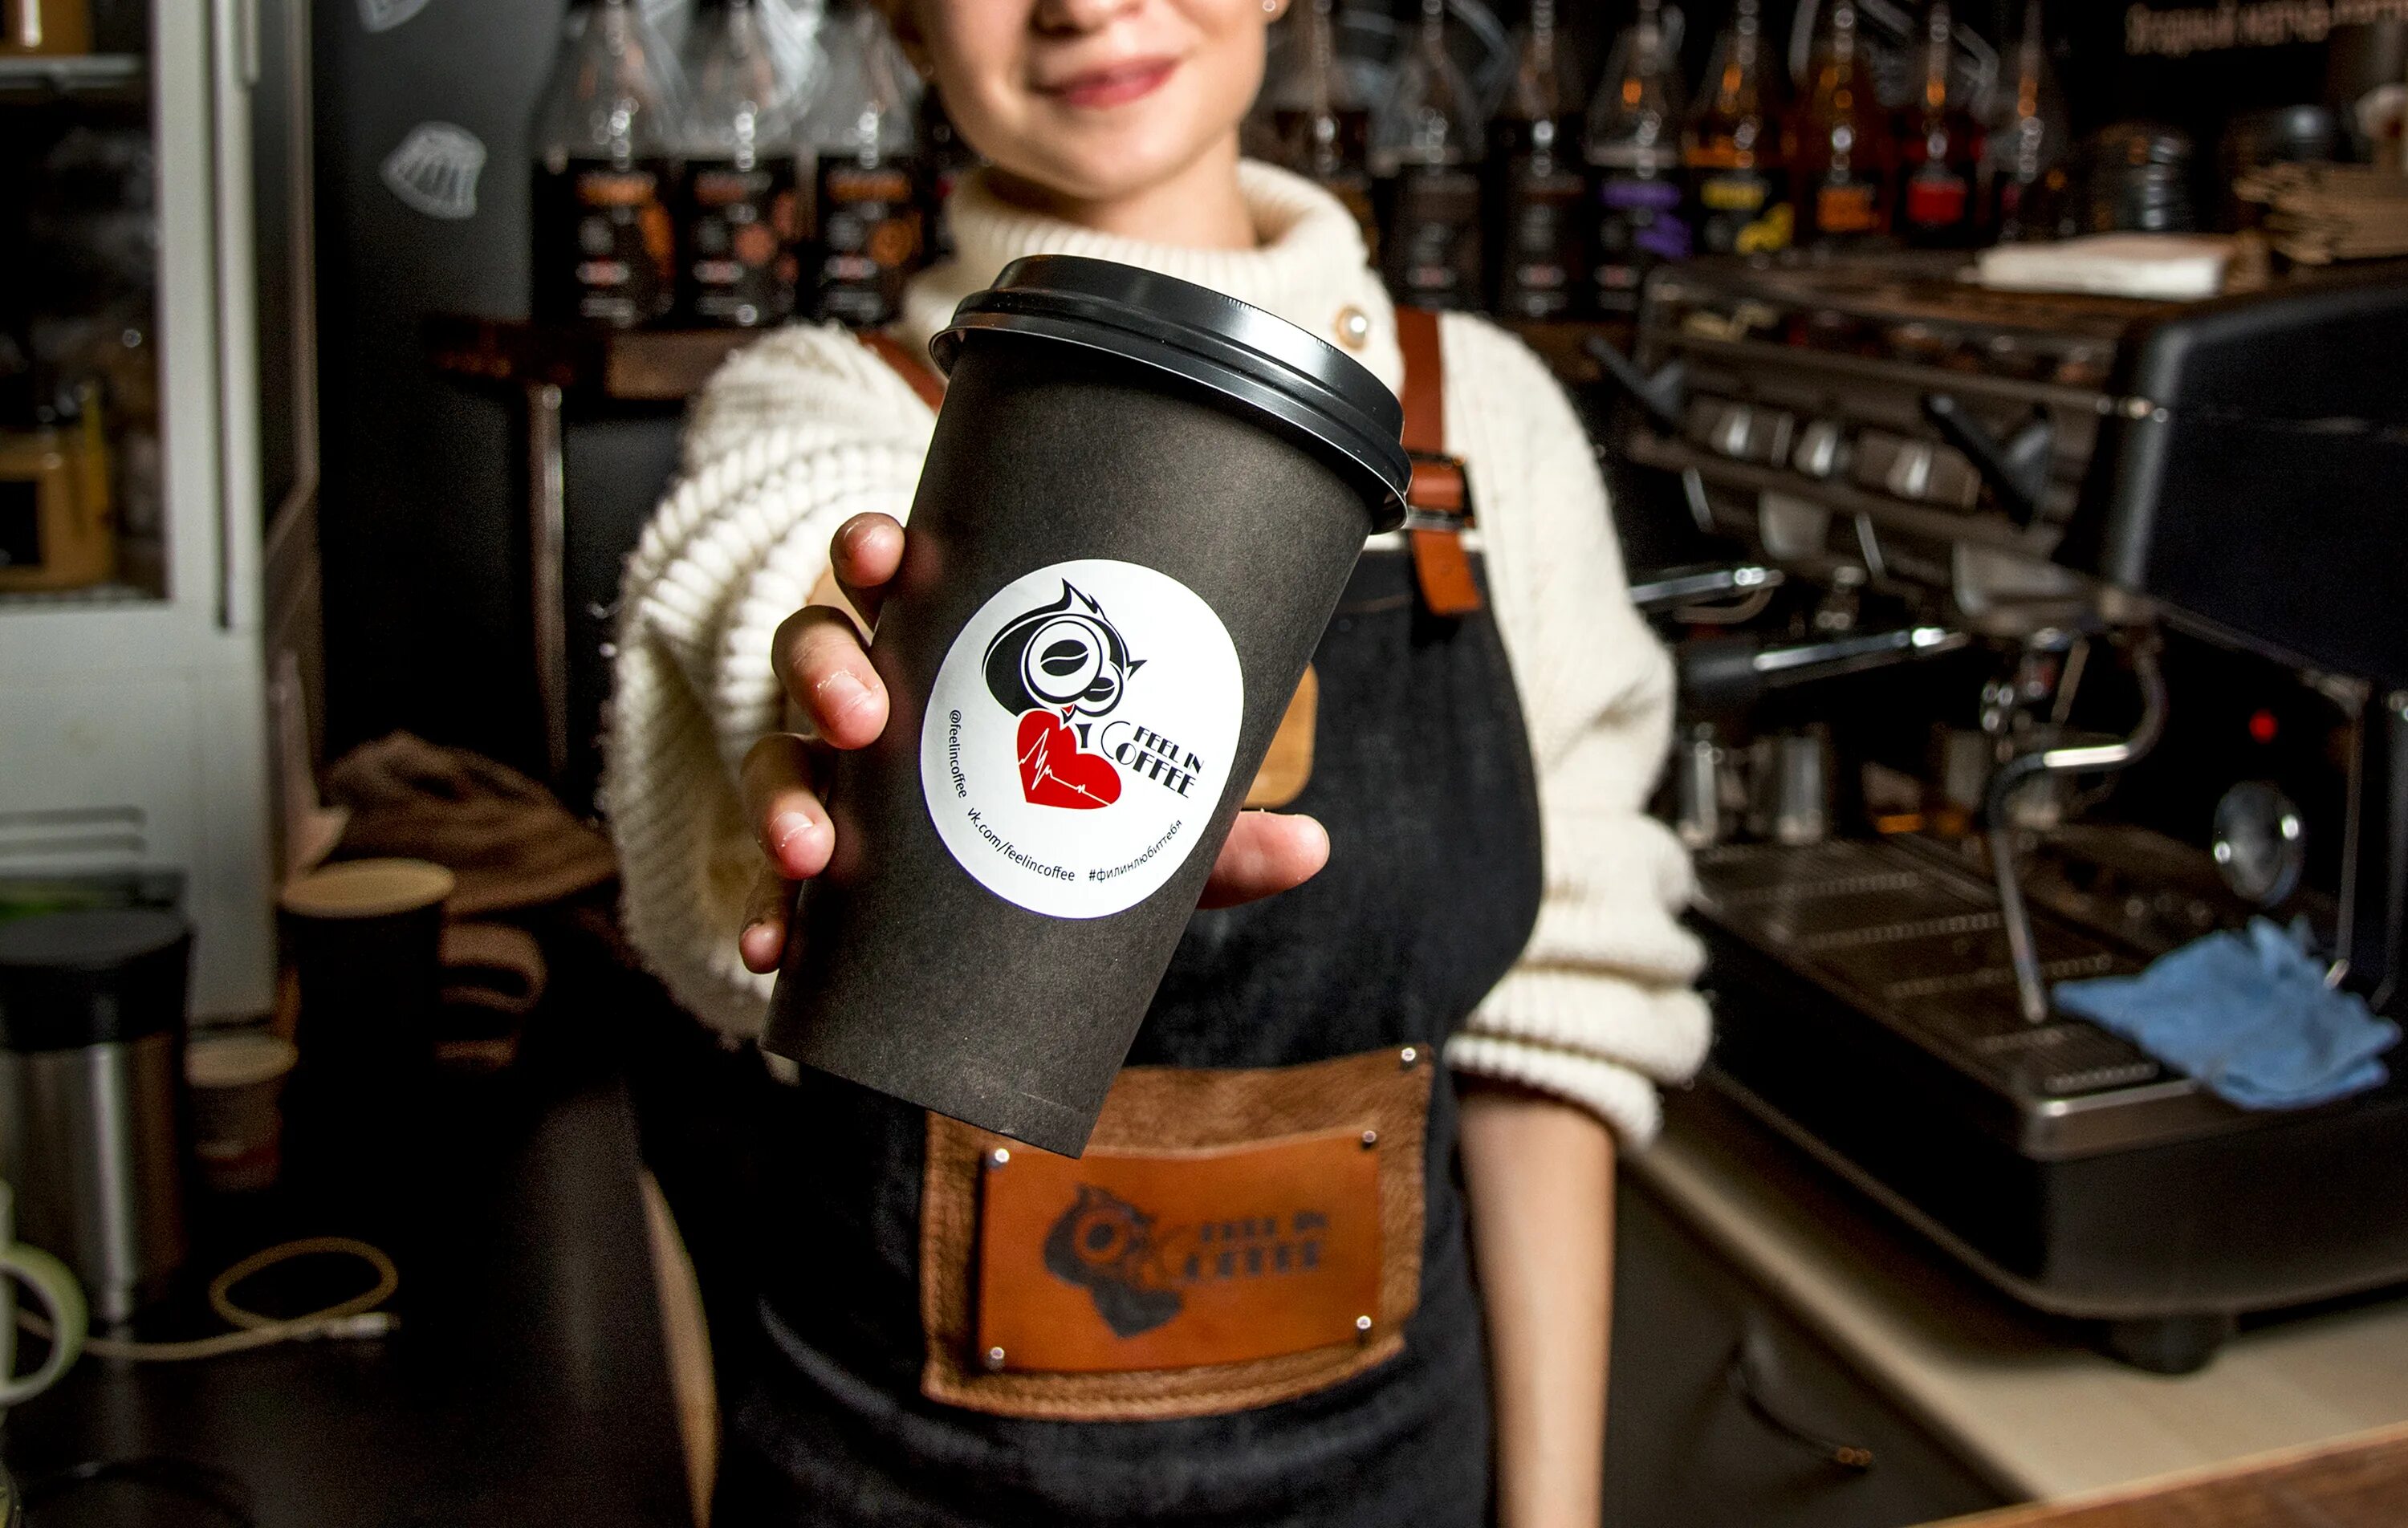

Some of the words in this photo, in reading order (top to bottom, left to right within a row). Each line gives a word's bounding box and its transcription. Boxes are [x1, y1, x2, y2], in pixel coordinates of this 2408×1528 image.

[949, 709, 967, 799] @feelincoffee
[1100, 721, 1196, 799] COFFEE
[1133, 725, 1179, 763] FEEL
[1183, 752, 1205, 774] IN
[967, 807, 1076, 881] vk.com/feelincoffee
[1088, 819, 1182, 884] #филинлюбиттебя
